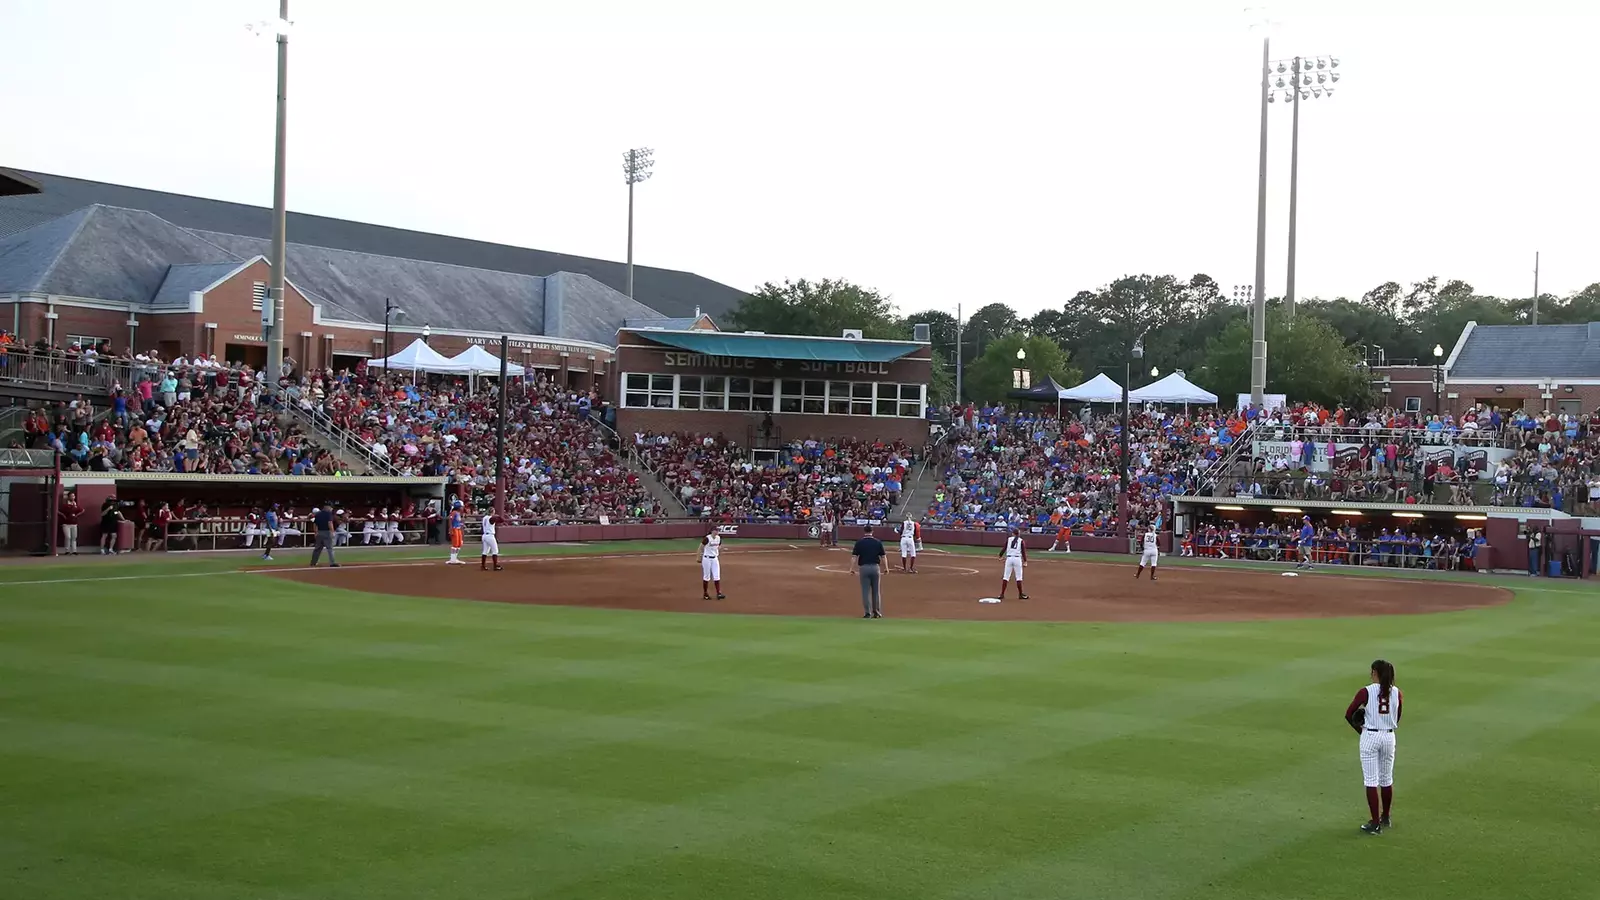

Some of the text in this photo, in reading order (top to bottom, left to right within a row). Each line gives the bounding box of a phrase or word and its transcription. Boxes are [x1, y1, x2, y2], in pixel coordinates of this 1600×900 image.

[466, 337, 486, 345] MARY
[664, 352, 889, 375] SEMINOLE SOFTBALL
